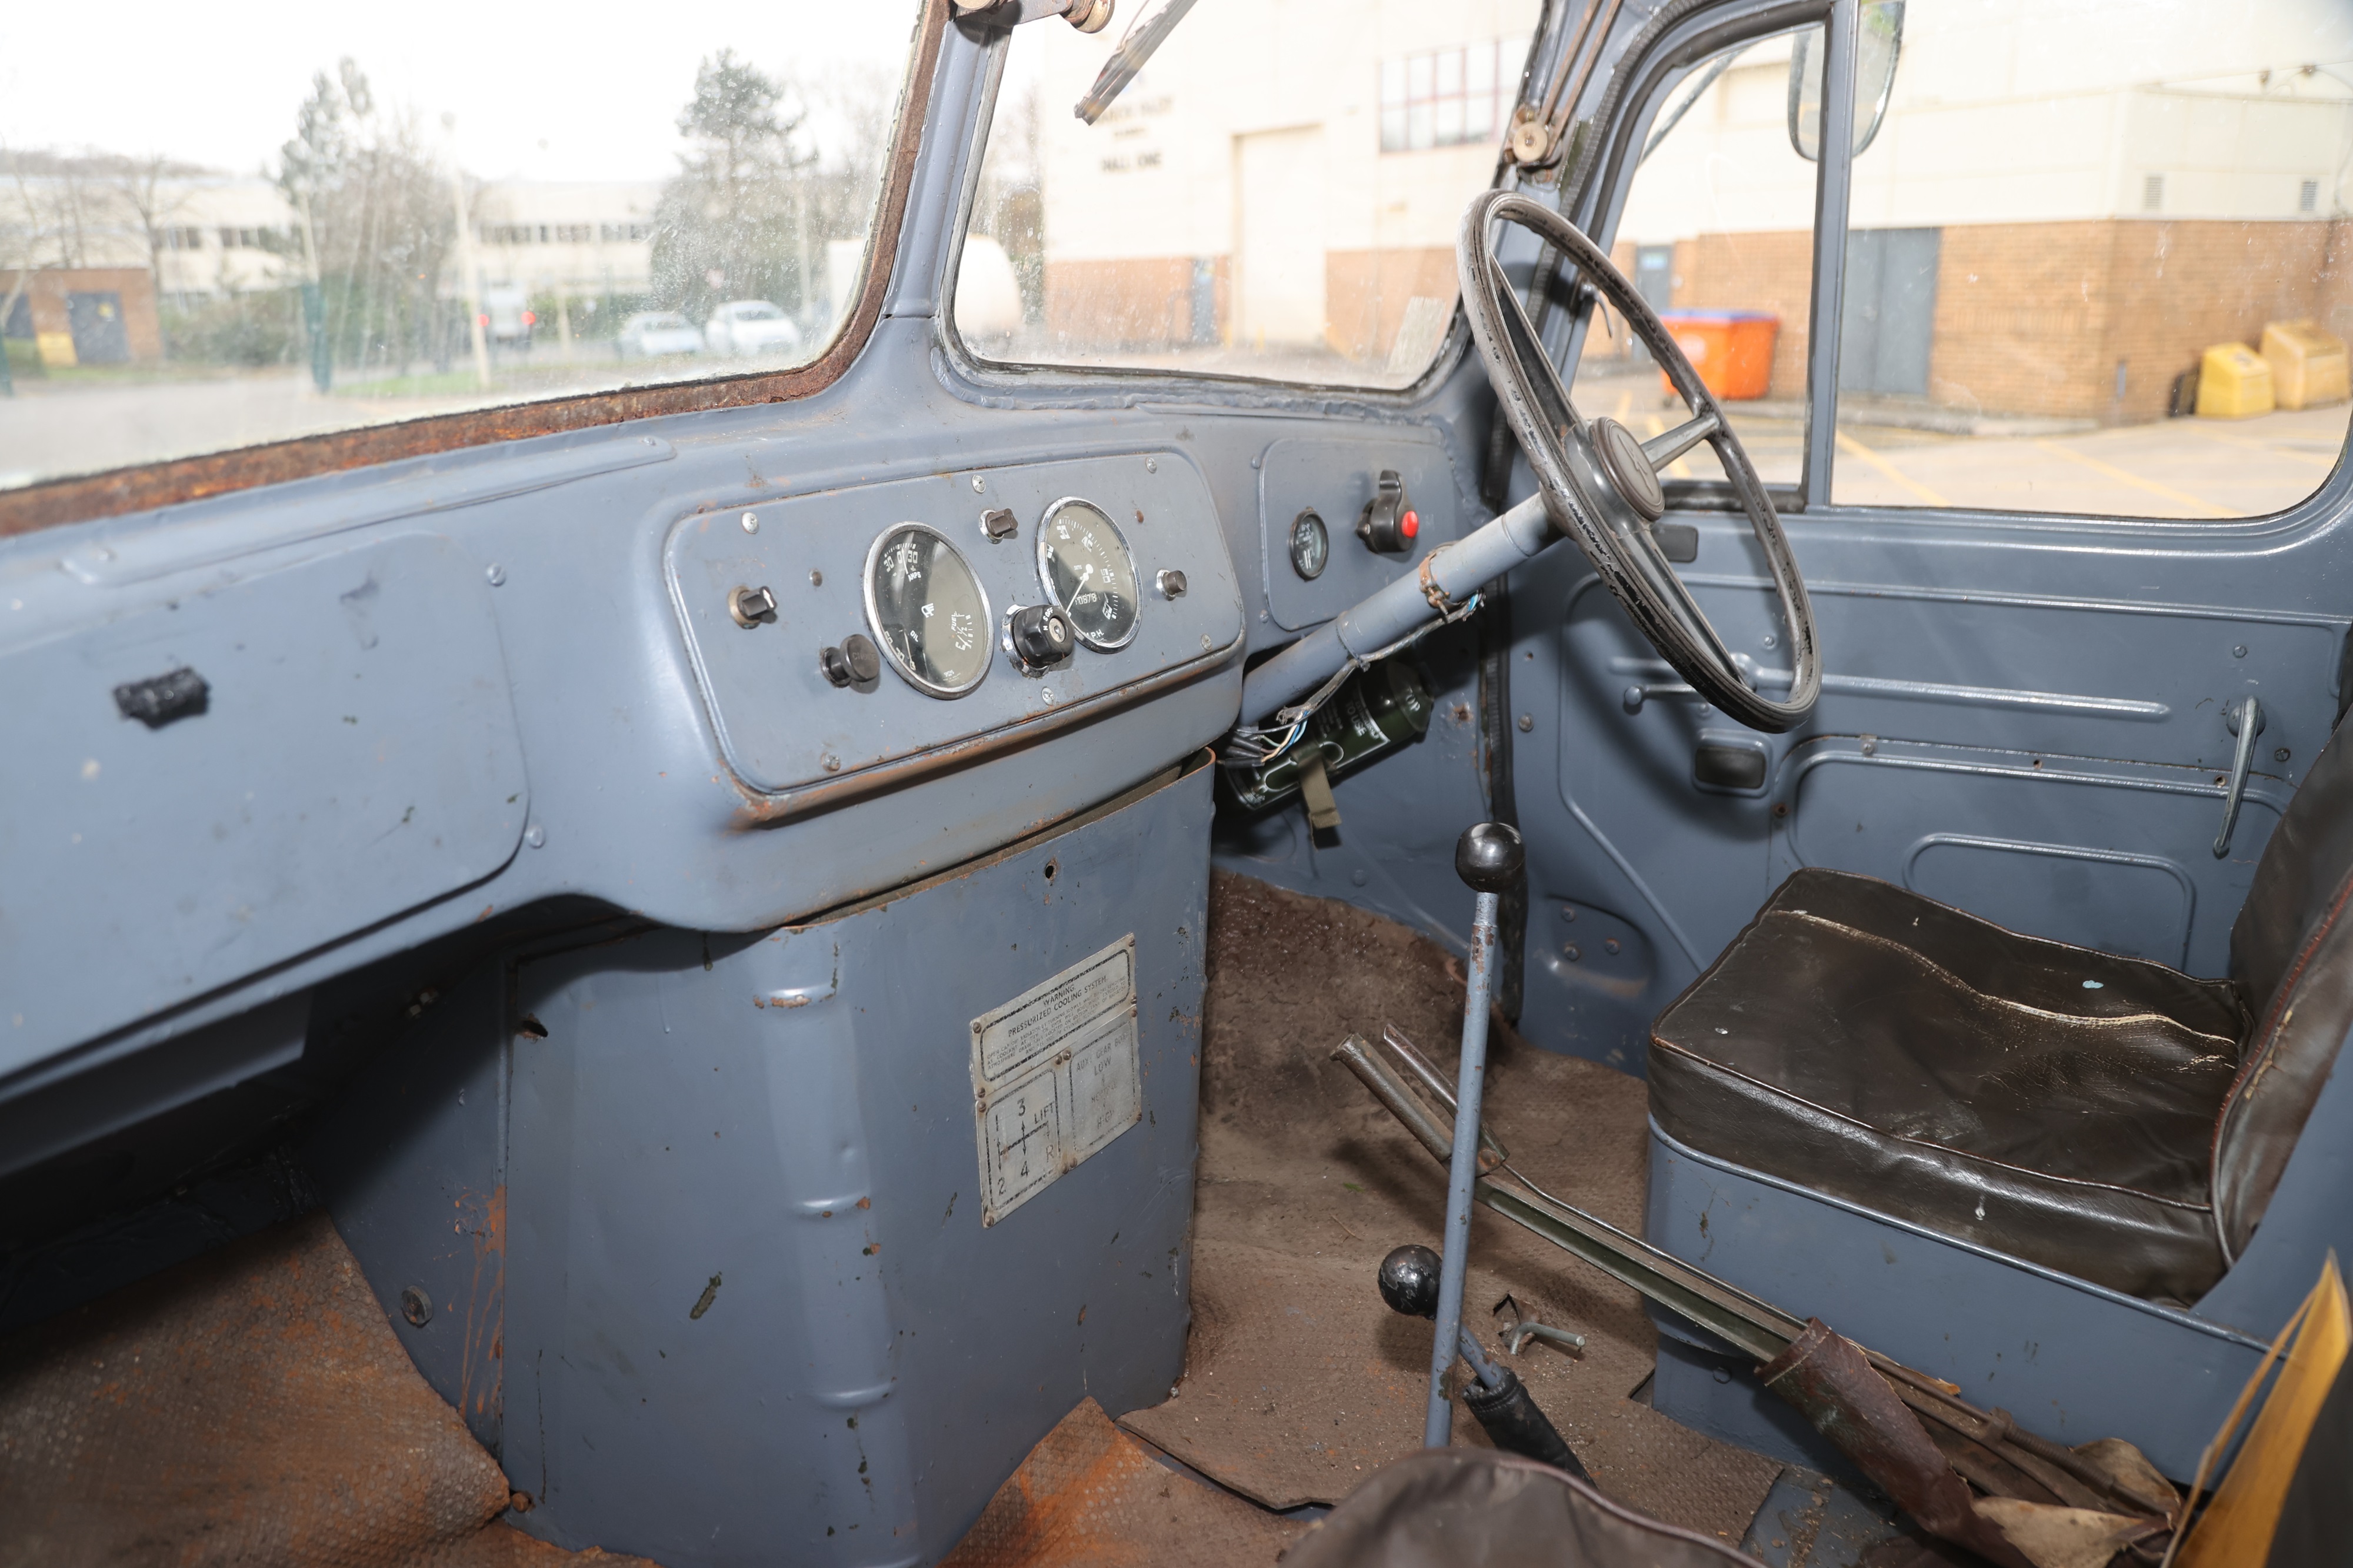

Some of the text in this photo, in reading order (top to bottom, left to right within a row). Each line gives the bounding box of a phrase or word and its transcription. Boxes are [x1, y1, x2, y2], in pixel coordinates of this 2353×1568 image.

[1056, 525, 1071, 539] 30
[884, 556, 895, 572] 30
[897, 551, 902, 563] 0
[908, 551, 918, 563] 30
[908, 571, 921, 582] AMPS
[1101, 568, 1111, 583] 50
[1045, 607, 1054, 618] OFF
[1102, 602, 1112, 619] 60
[910, 630, 918, 642] OIL
[1405, 686, 1421, 712] TOP
[1345, 700, 1356, 715] TO
[1351, 714, 1367, 737] USE
[1044, 983, 1075, 1007] WARNING.
[1008, 1007, 1051, 1037] PRESSURIZED
[1054, 989, 1082, 1011] COOLING
[1084, 975, 1107, 993] SYSTEM.
[996, 1044, 1017, 1059] COOLANT
[1096, 1043, 1111, 1059] GEAR
[988, 1051, 1015, 1070] ATMOSPHERE
[1094, 1056, 1112, 1076] LOW
[1091, 1081, 1118, 1103] NEUTRAL
[1017, 1097, 1026, 1117] 3
[1034, 1101, 1055, 1124] LIFT
[1045, 1144, 1054, 1163] R
[1021, 1160, 1029, 1177] 4
[997, 1176, 1006, 1196] 2
